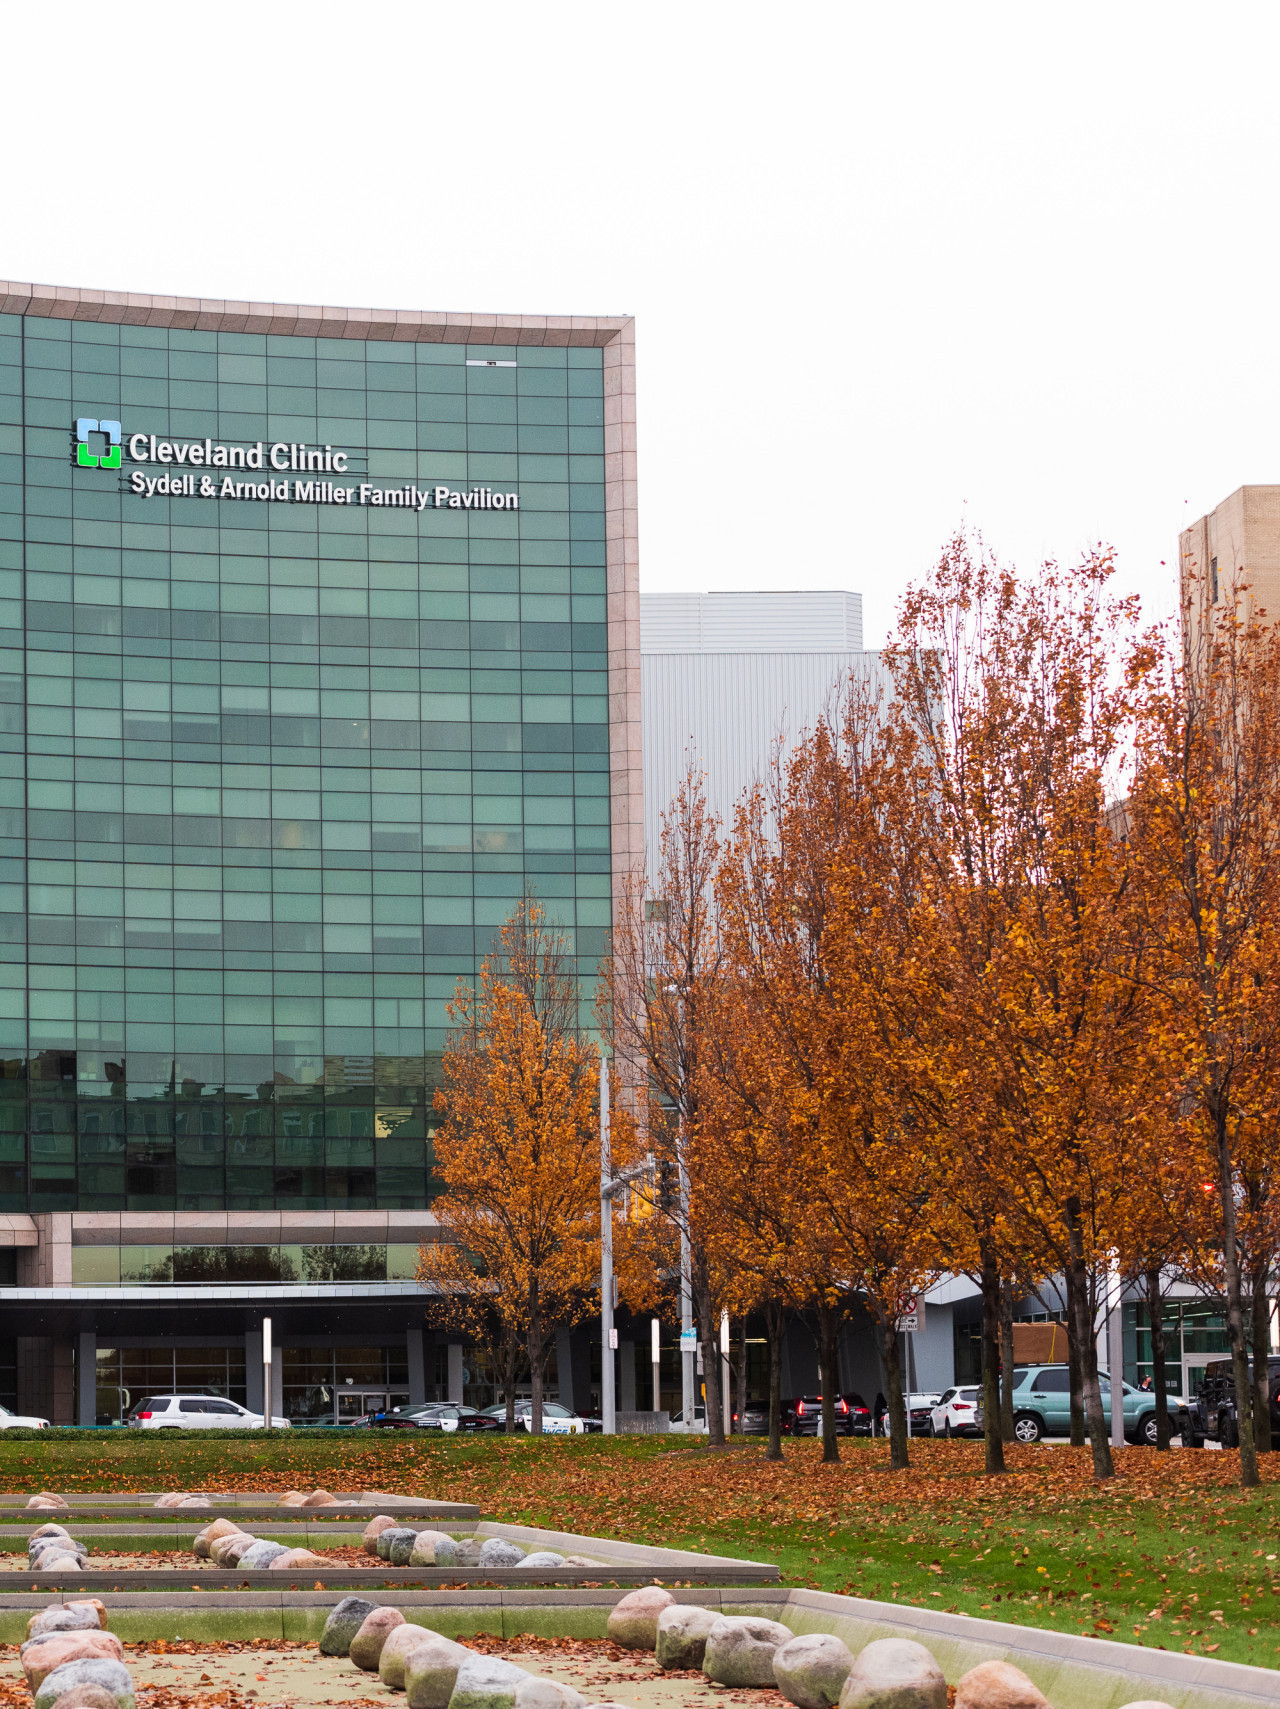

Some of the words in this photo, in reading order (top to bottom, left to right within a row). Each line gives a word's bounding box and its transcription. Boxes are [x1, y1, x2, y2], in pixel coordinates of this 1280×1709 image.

[129, 433, 263, 468] Cleveland
[271, 443, 348, 472] Clinic
[131, 470, 194, 498] Sydell
[199, 475, 216, 497] &
[220, 476, 289, 500] Arnold
[295, 480, 355, 503] Miller
[359, 483, 429, 510] Family
[435, 486, 519, 509] Pavilion
